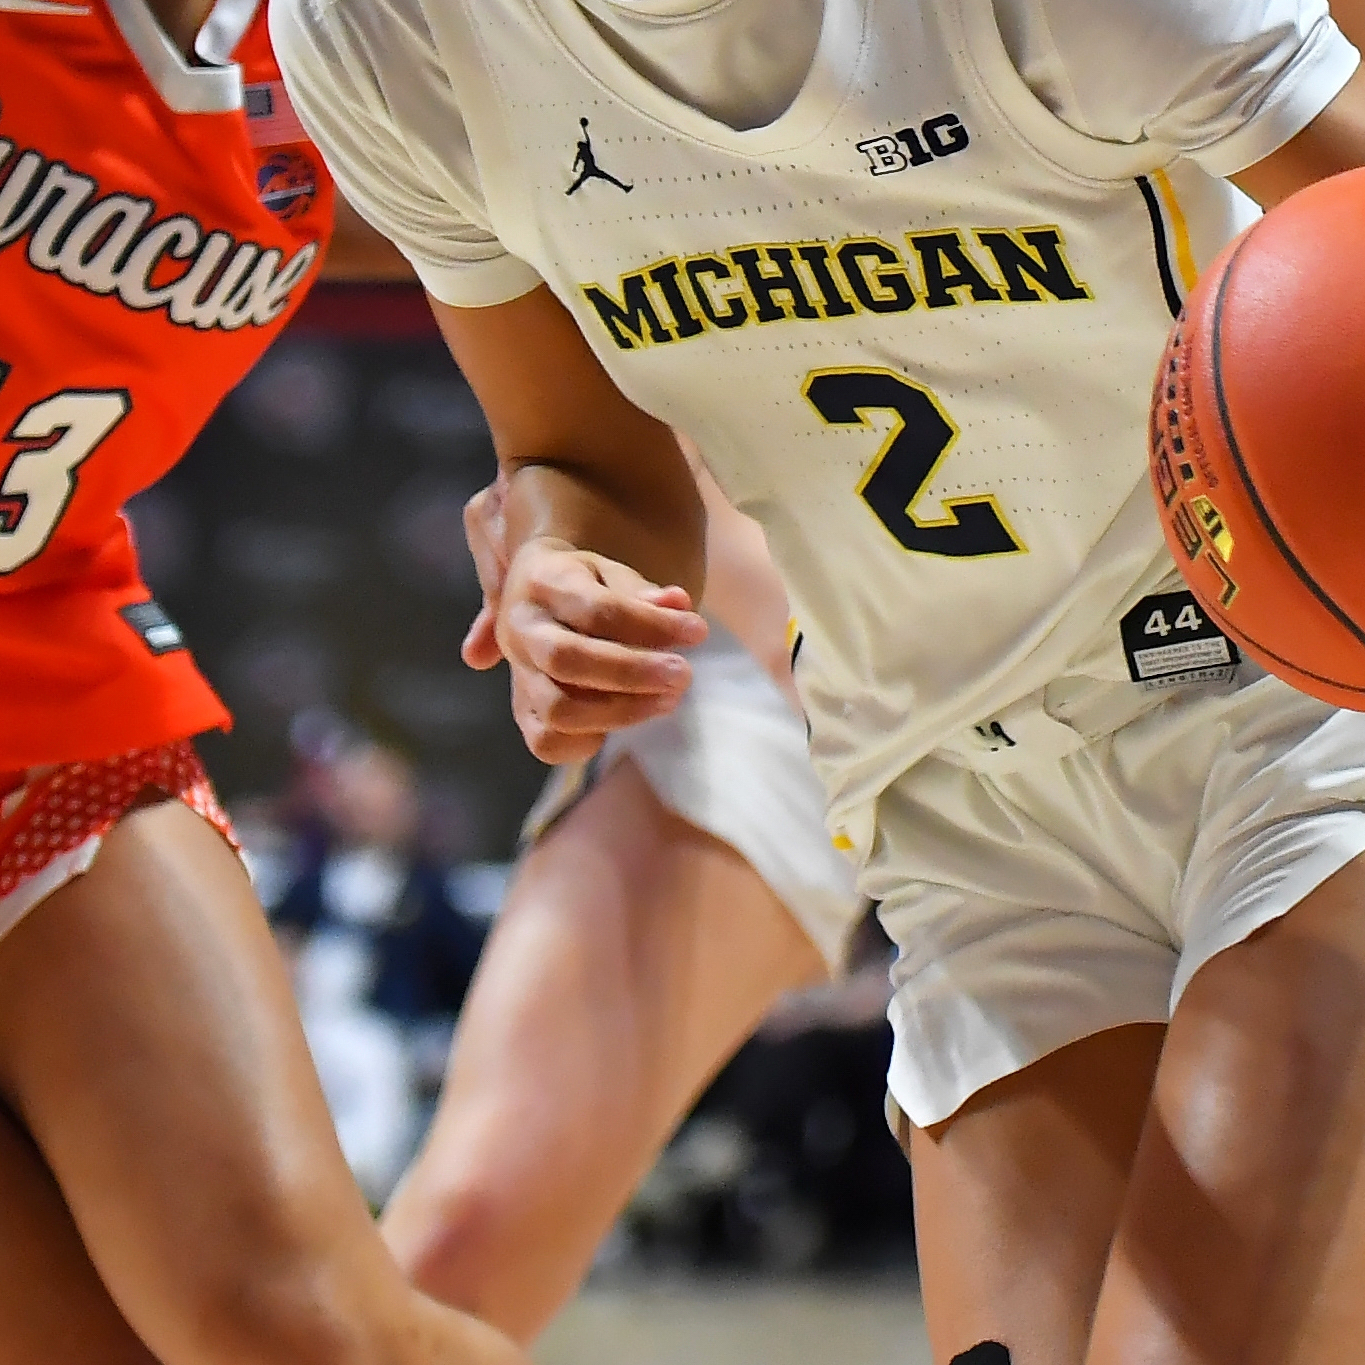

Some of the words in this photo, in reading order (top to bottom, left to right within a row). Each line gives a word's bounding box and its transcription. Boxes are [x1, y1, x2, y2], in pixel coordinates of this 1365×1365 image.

[579, 224, 1095, 352] MICHIGAN
[799, 364, 1029, 558] 2
[1144, 603, 1203, 637] 44
